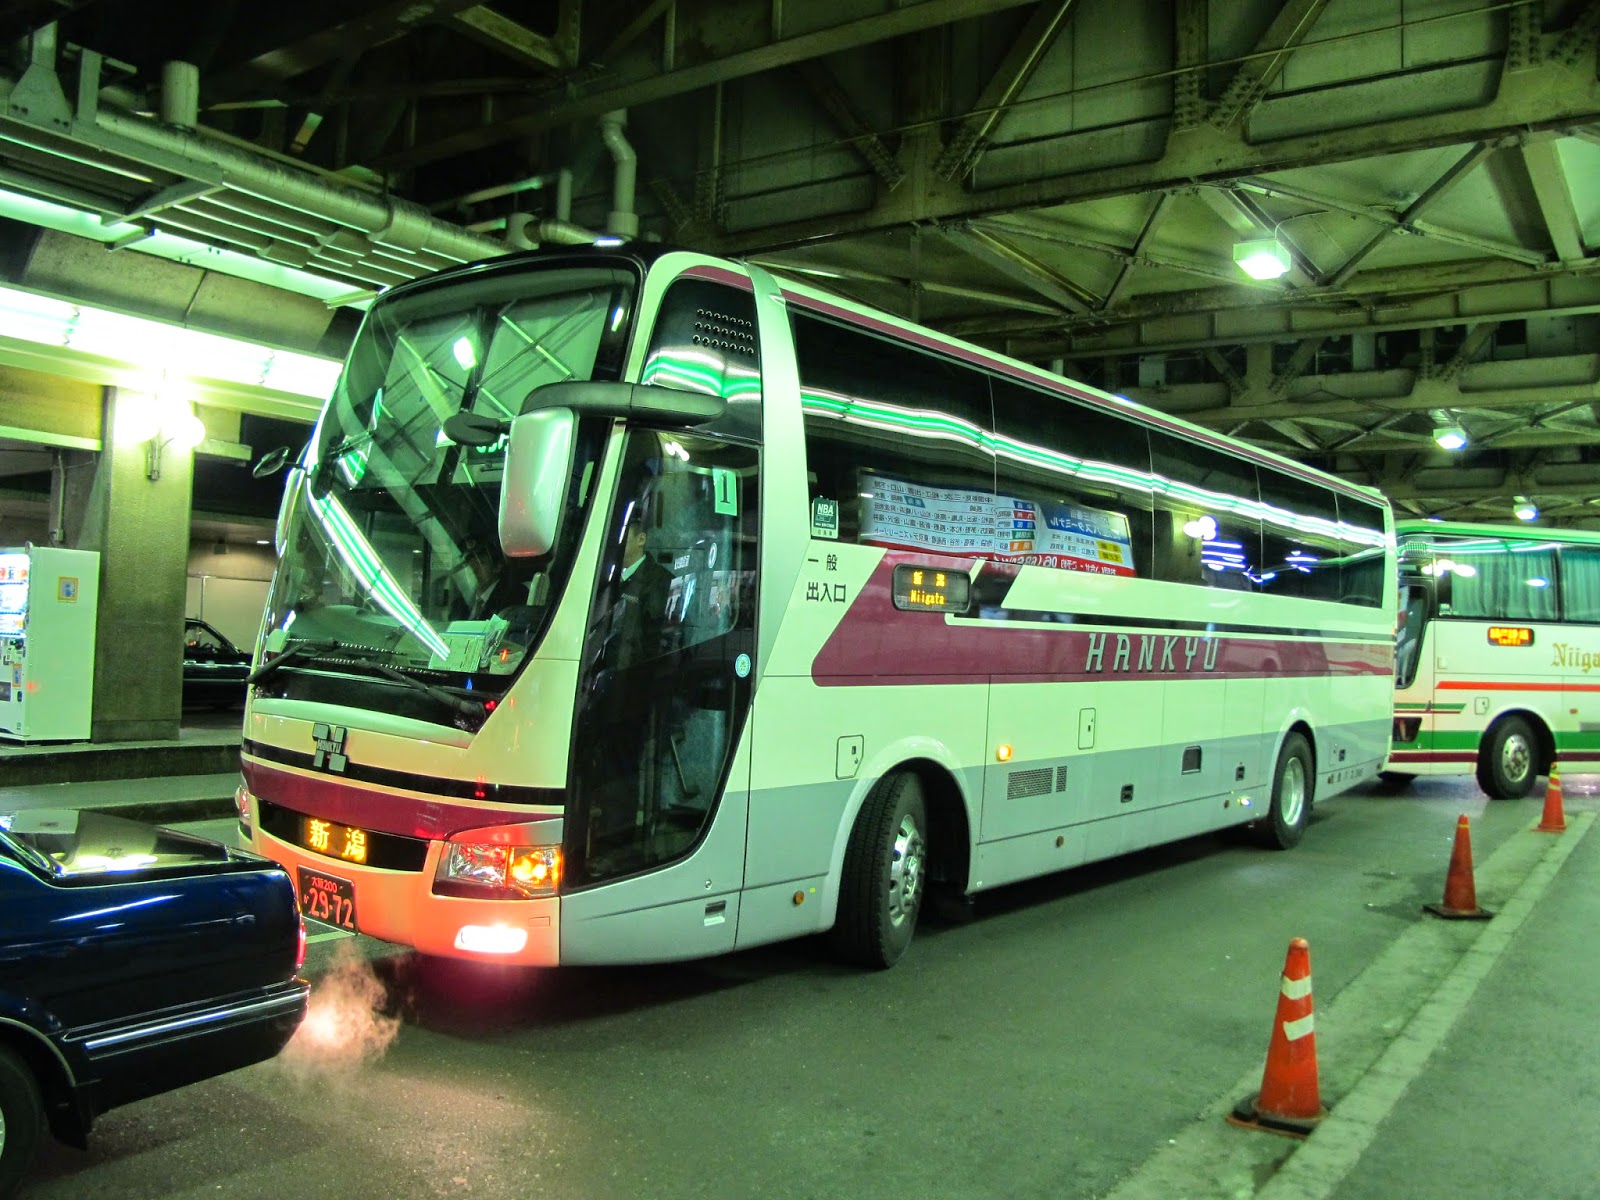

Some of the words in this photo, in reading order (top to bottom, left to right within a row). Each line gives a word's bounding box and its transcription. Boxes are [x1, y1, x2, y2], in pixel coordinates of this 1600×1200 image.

[817, 503, 833, 515] NBA
[807, 553, 838, 572] 一般
[806, 581, 846, 603] 出入口
[910, 590, 945, 605] Niigata
[1085, 633, 1219, 672] HANKYU
[309, 819, 366, 860] 新潟
